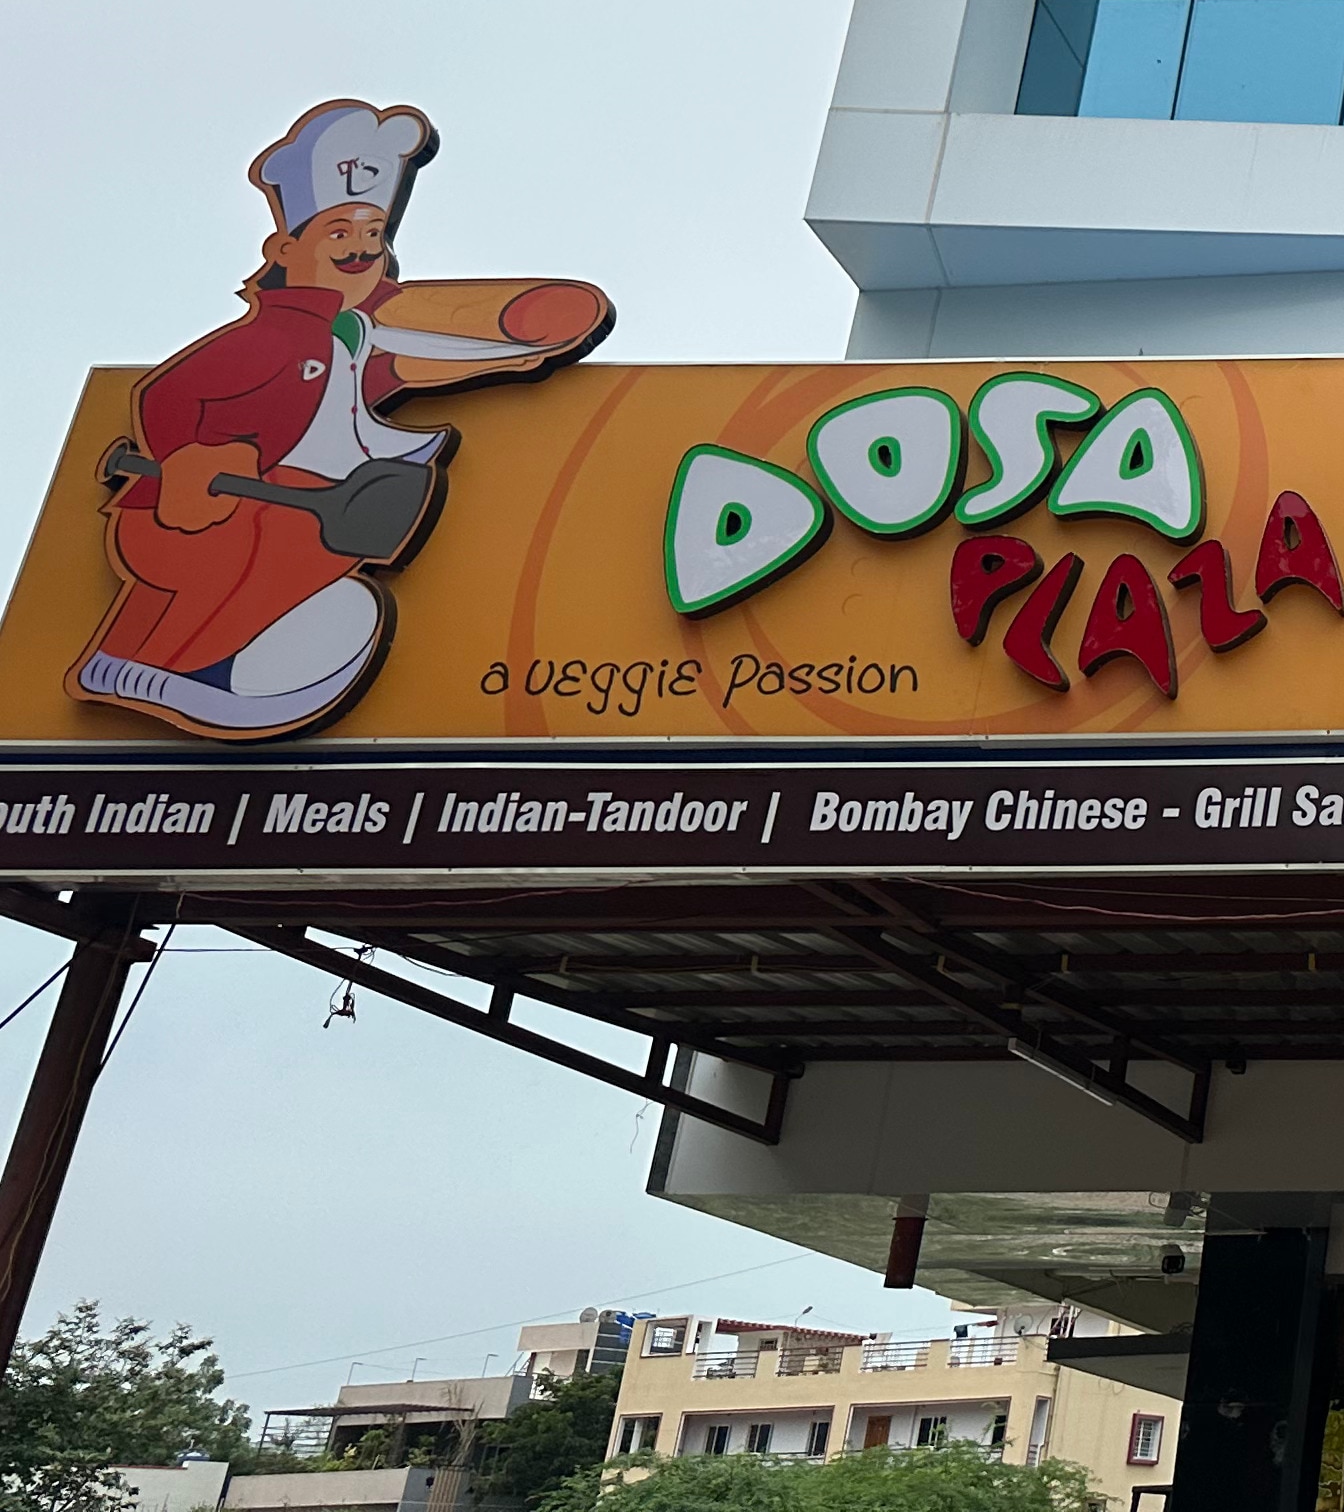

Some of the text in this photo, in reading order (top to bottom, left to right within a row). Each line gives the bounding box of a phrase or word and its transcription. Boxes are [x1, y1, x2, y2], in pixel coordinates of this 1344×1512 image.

[663, 370, 1209, 621] DOSA
[480, 660, 510, 696] a
[84, 793, 215, 834] Indian
[262, 793, 390, 834] Meals
[437, 791, 749, 833] Indian-Tandoor
[809, 791, 974, 841] Bombay
[985, 789, 1148, 831] Chinese
[1194, 786, 1282, 829] Grill
